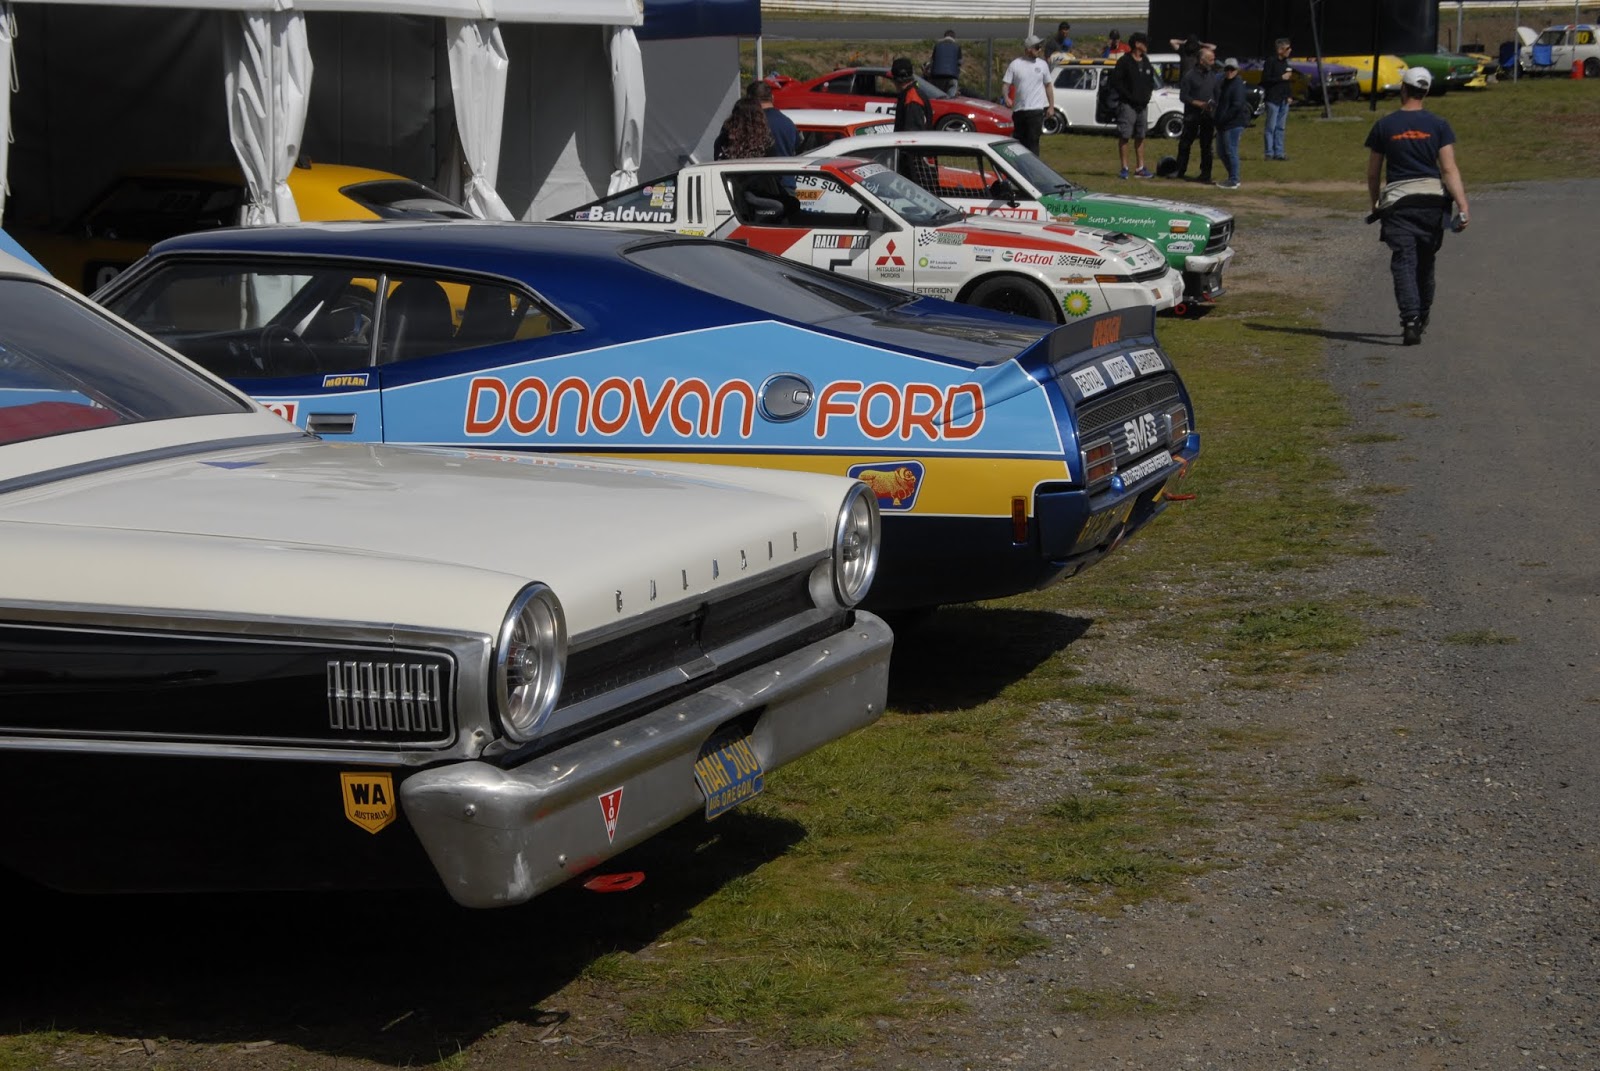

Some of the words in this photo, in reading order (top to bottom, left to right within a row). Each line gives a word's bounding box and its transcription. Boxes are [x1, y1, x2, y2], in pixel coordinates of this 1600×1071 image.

[589, 206, 672, 222] Baldwin
[1047, 203, 1061, 212] Phil
[1062, 204, 1069, 213] &
[1071, 204, 1087, 213] Kim
[1169, 233, 1206, 241] YOKOHAMA
[1013, 252, 1054, 266] Castrol
[326, 376, 366, 387] MOYLAN
[813, 381, 986, 440] FORD
[694, 751, 732, 794] HAH
[350, 783, 387, 805] WA
[721, 778, 753, 806] OREGON
[354, 809, 389, 820] AUSTRALIA
